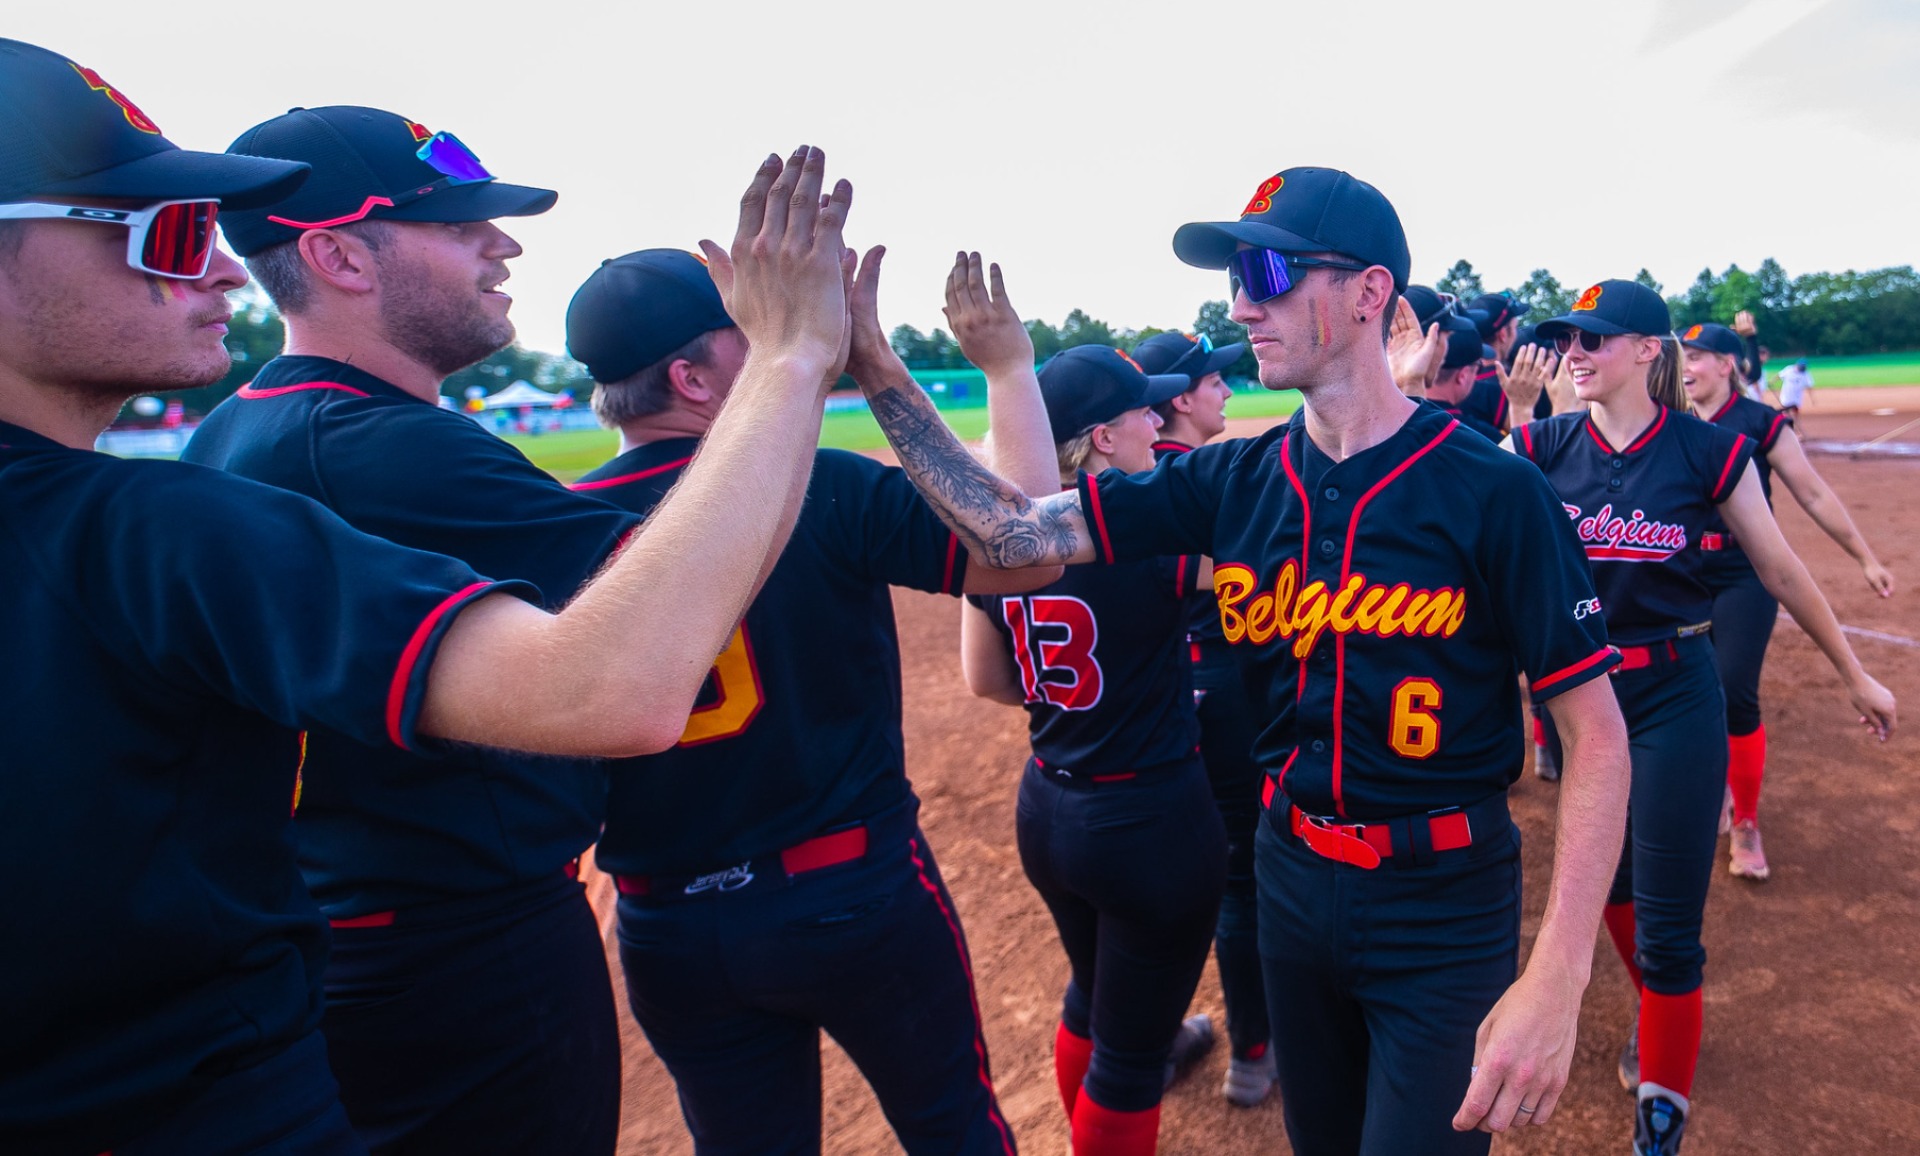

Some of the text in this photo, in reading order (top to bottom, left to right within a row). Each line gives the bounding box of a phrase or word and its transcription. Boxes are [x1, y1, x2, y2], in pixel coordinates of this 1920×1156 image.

[1571, 285, 1603, 311] B
[1002, 595, 1104, 711] 13
[1213, 557, 1467, 659] Belgium
[1387, 676, 1443, 760] 6
